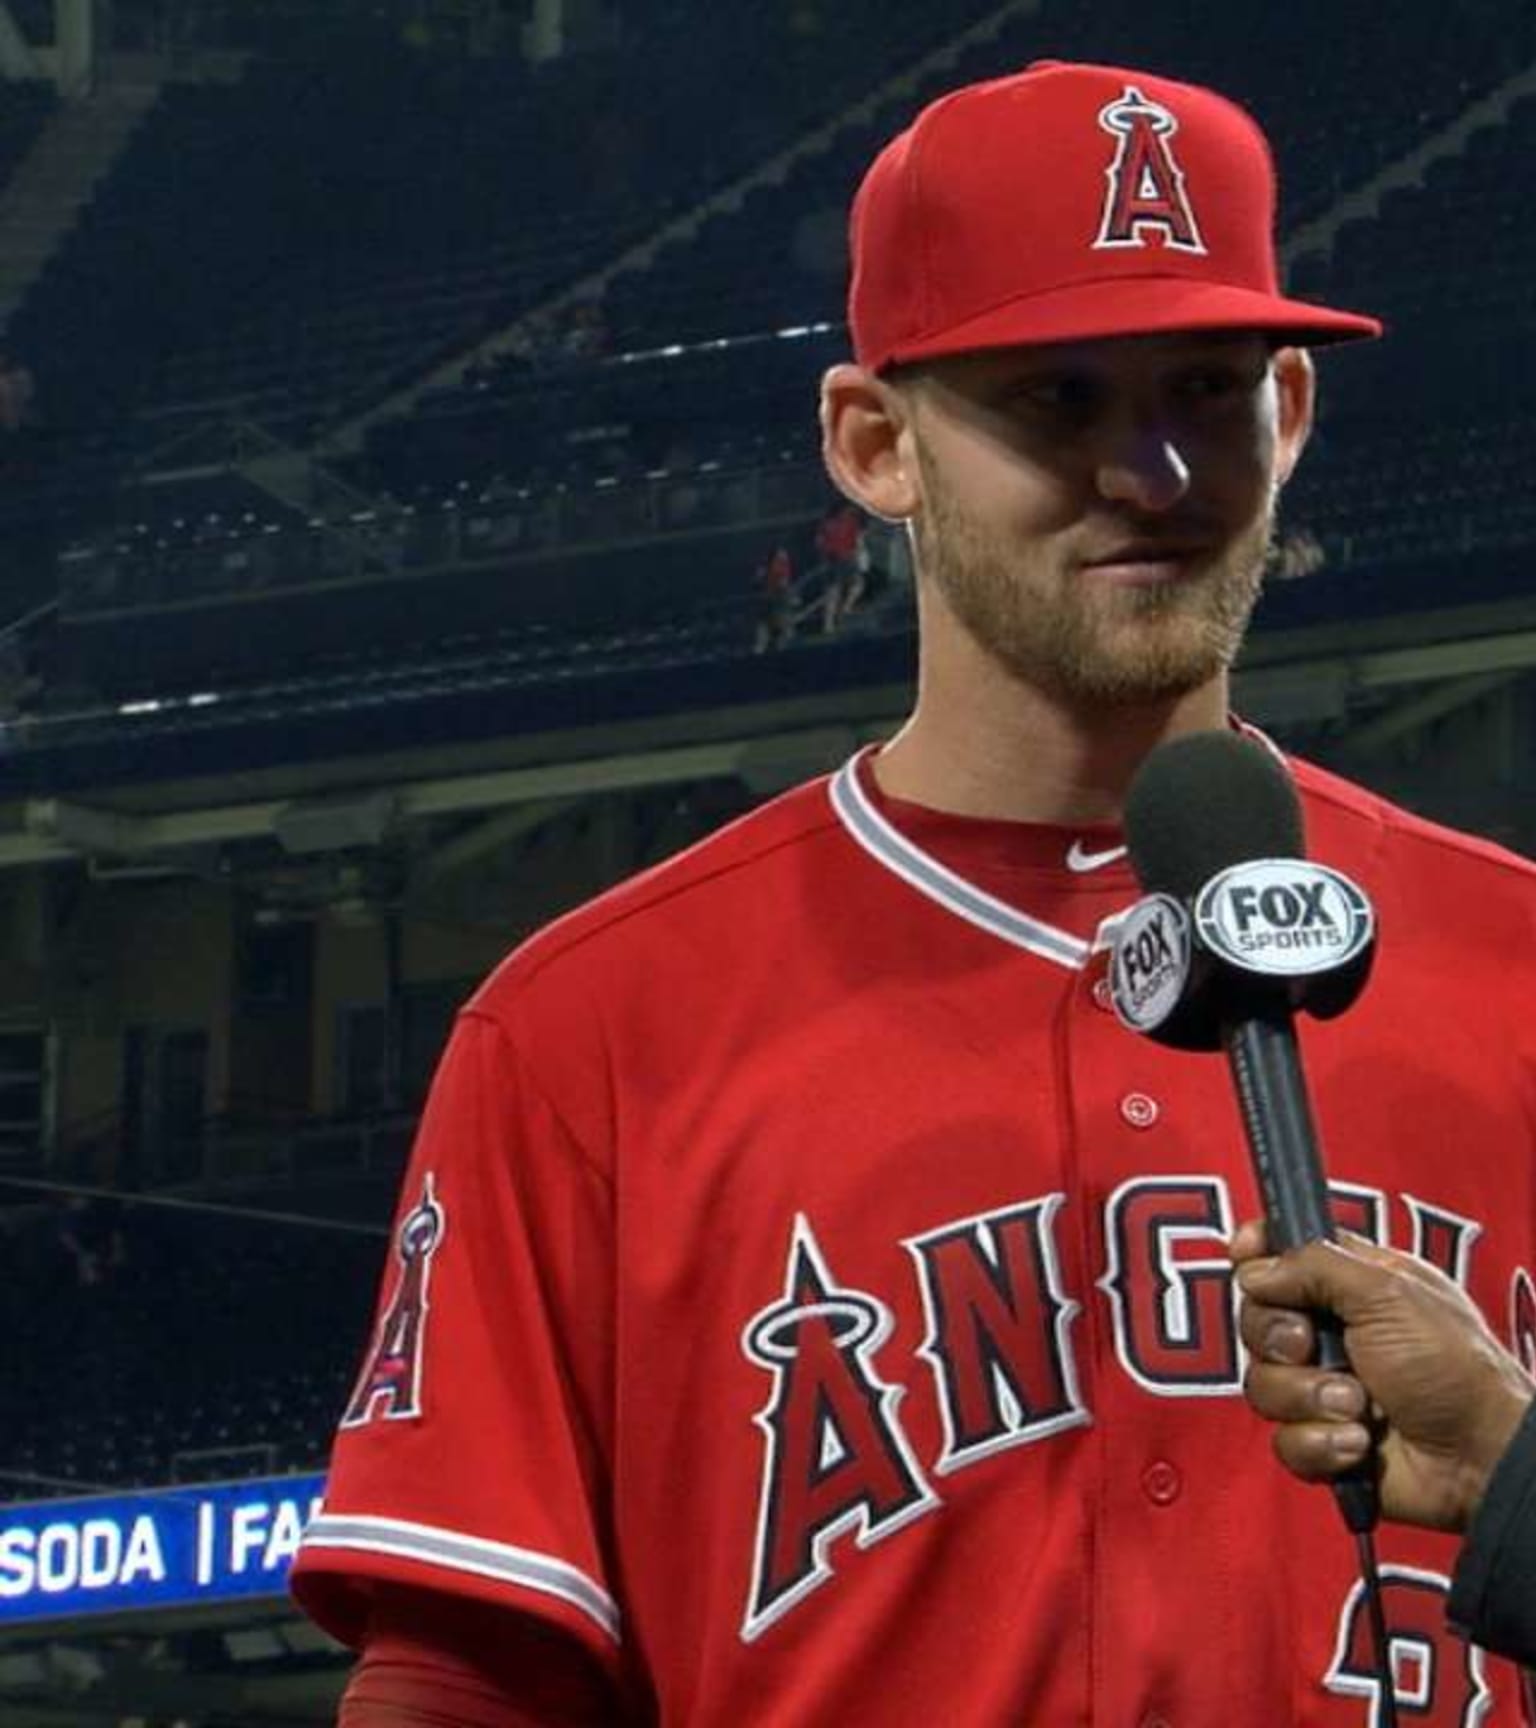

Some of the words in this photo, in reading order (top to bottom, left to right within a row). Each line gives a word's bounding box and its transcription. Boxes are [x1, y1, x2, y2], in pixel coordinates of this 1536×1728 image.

[1091, 85, 1209, 256] A
[1122, 911, 1172, 993] FOX
[1228, 881, 1335, 932] FOX
[1239, 927, 1344, 952] SPORTS
[338, 1170, 446, 1430] A
[0, 1514, 167, 1597] SODA
[231, 1496, 324, 1574] FA
